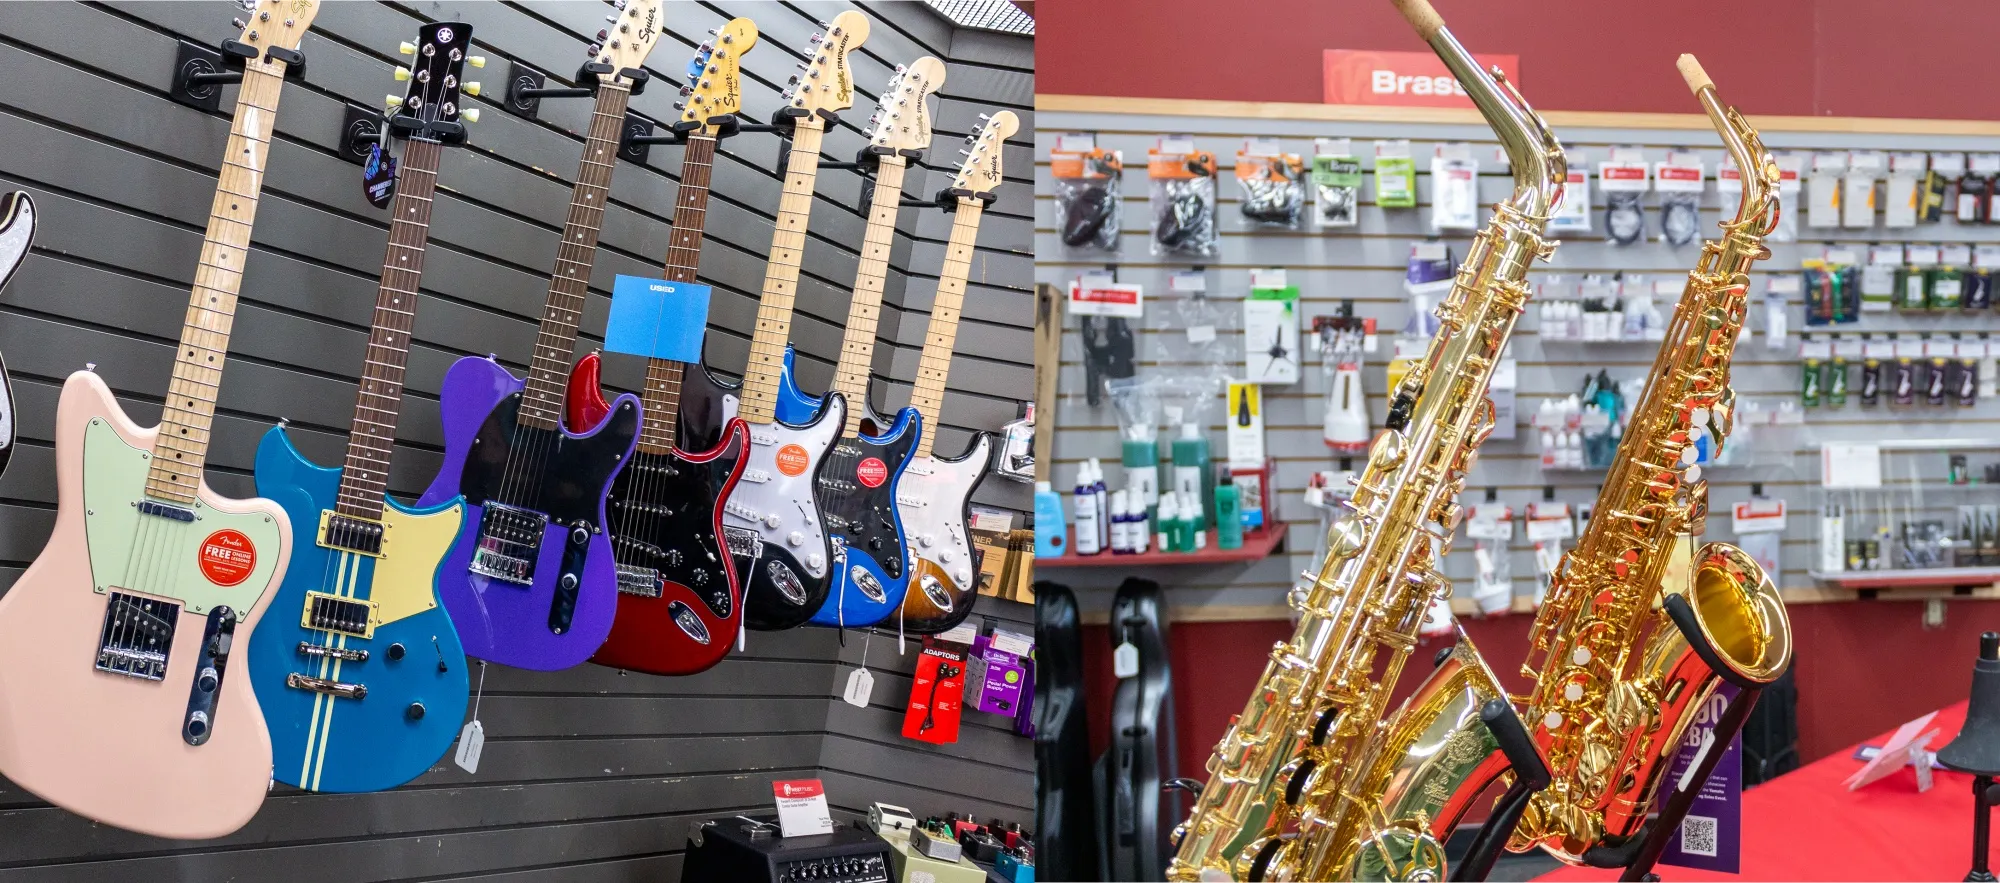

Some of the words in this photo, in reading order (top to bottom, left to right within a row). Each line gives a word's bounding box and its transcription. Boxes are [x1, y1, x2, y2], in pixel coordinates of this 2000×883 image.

[638, 7, 657, 44] Squier
[837, 33, 850, 70] STRATOCASTER
[723, 74, 739, 107] Squier
[836, 71, 852, 103] Squier
[916, 80, 930, 113] STRATOCASTER
[915, 114, 929, 144] Squier
[987, 154, 1001, 182] Squier
[650, 285, 675, 293] USED
[779, 454, 795, 462] FREE
[205, 546, 231, 559] FREE
[232, 551, 252, 559] ONLINE
[220, 536, 242, 546] Fender
[924, 648, 960, 661] ADAPTORS
[1001, 682, 1018, 690] Power
